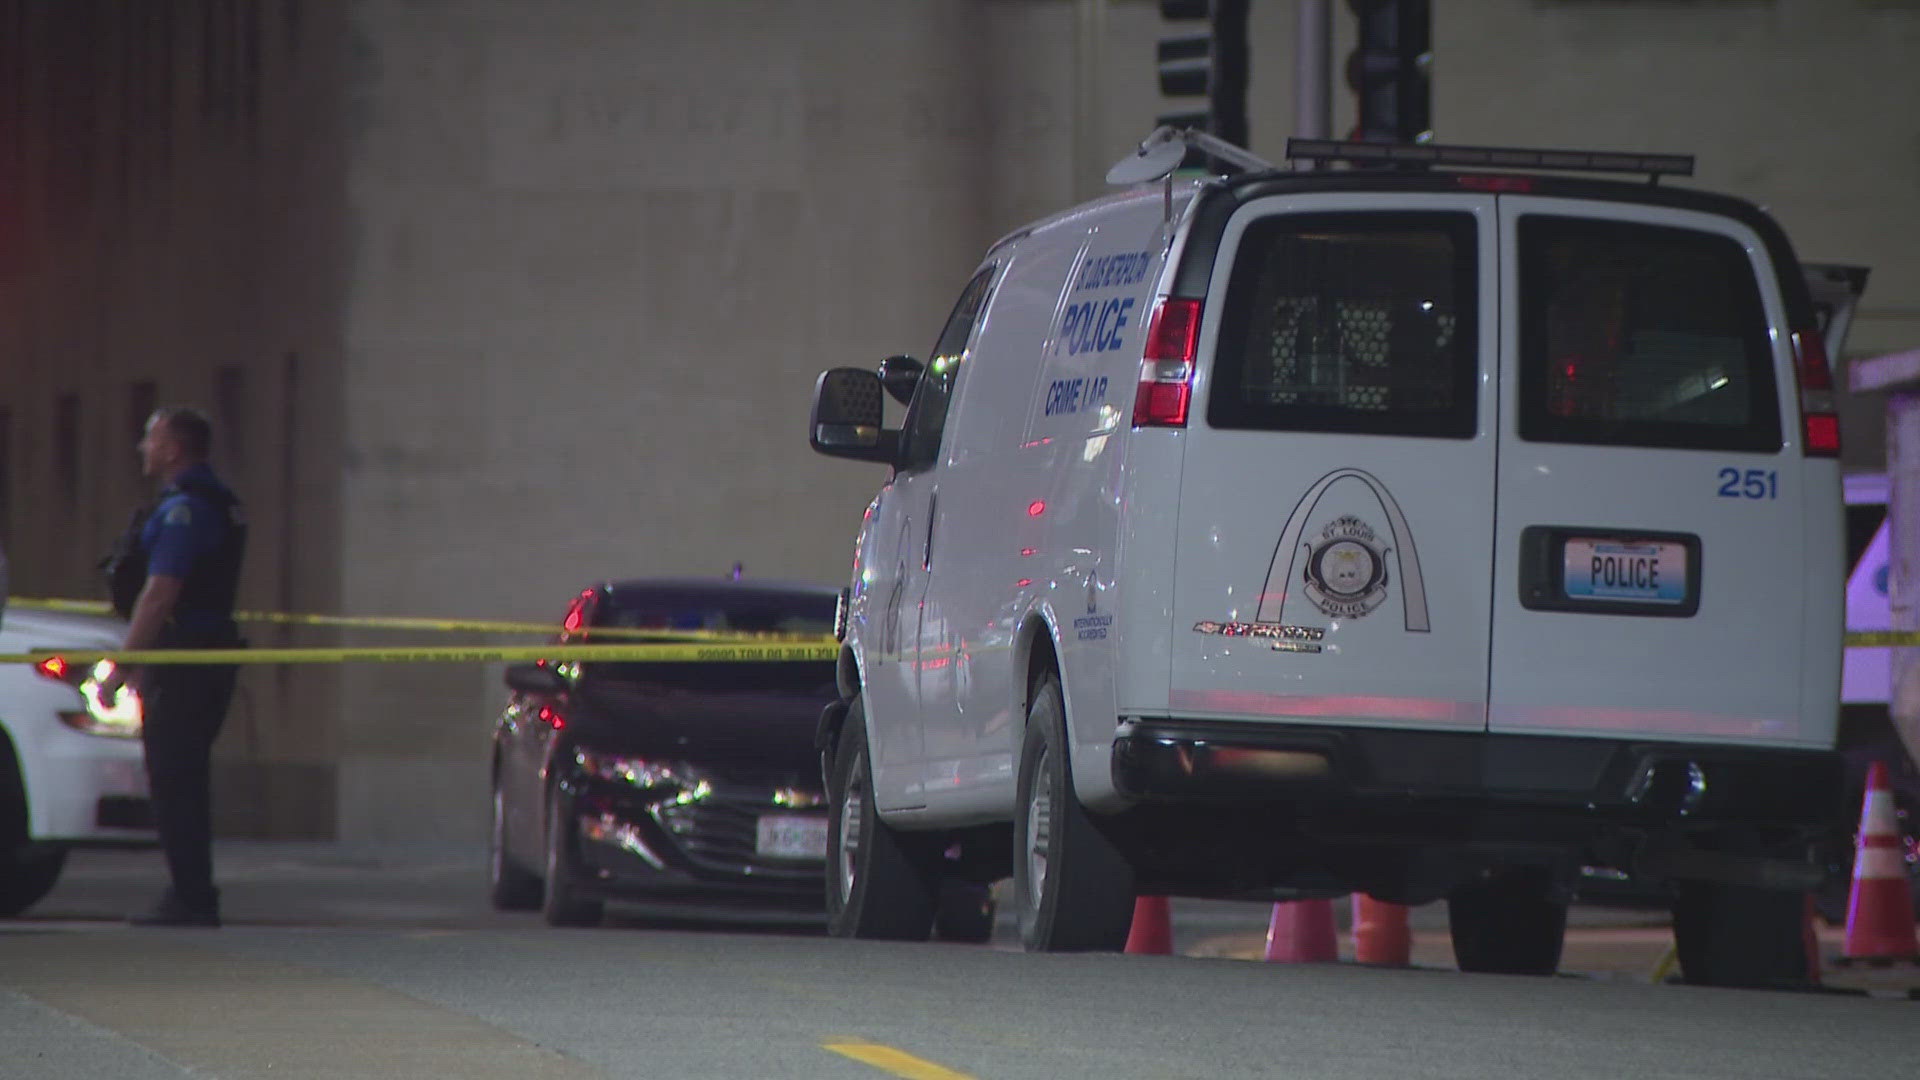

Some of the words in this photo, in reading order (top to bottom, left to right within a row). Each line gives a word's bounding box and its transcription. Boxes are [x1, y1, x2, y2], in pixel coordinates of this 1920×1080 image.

[1055, 297, 1135, 356] POLICE
[1045, 378, 1083, 417] CRIME
[1718, 466, 1777, 500] 251
[1591, 555, 1660, 589] POLICE
[1321, 598, 1369, 614] POLICE
